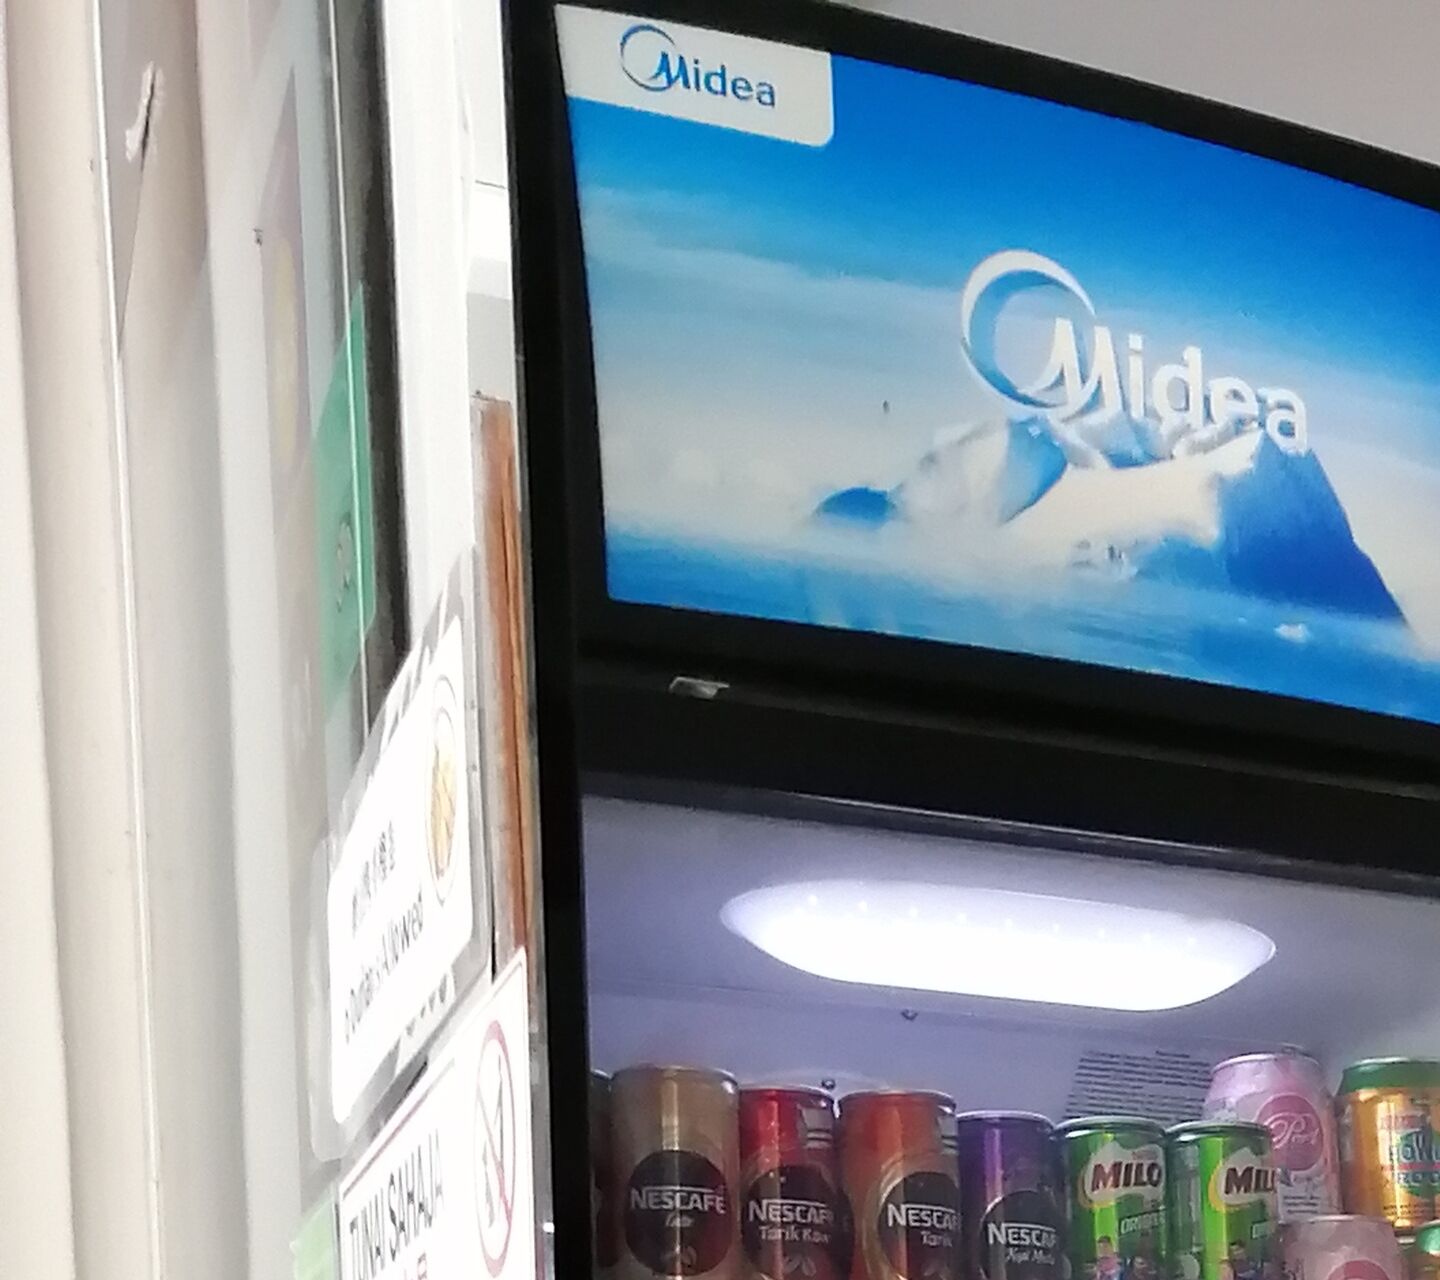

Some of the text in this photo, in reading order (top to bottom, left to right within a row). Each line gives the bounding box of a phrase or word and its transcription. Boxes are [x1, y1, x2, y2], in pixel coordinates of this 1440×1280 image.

[642, 44, 777, 110] Midea
[1010, 300, 1309, 458] Midea
[387, 1126, 443, 1263] SAHAJA
[1091, 1161, 1163, 1190] MILO
